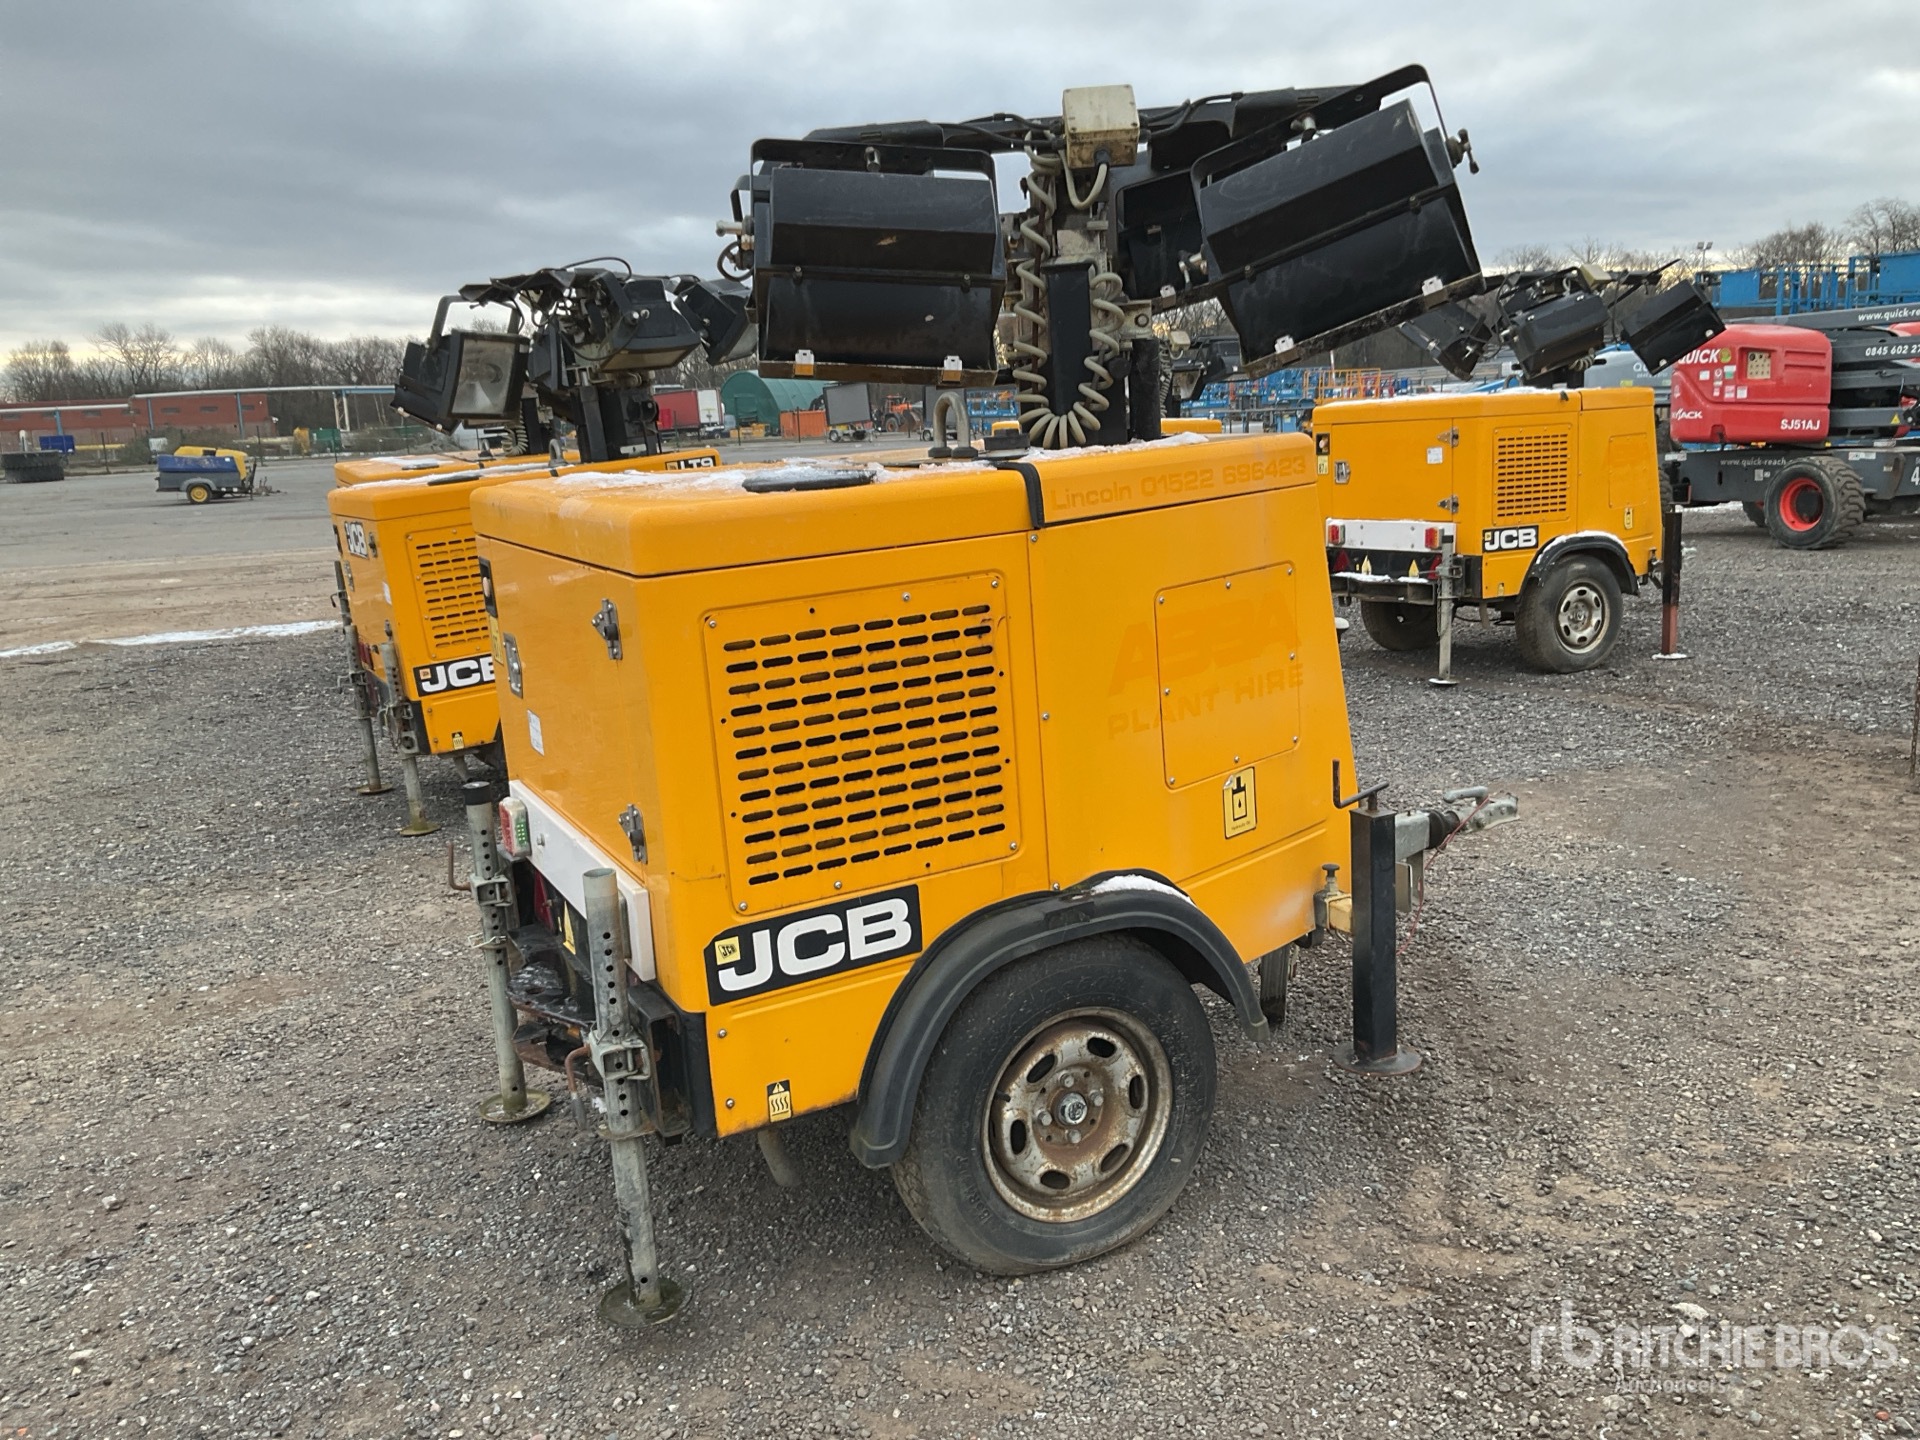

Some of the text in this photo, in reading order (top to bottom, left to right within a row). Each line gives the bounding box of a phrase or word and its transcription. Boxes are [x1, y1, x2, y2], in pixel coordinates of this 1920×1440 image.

[1865, 346, 1888, 356] 0845
[1890, 345, 1909, 355] 602
[1780, 419, 1820, 431] SJ51AJ
[1051, 481, 1132, 511] Lincoln
[1140, 468, 1214, 498] 01522
[1484, 528, 1537, 551] JCB
[1108, 588, 1302, 698] ABBA
[1107, 663, 1304, 739] PLANT HIRE
[718, 898, 912, 992] JCB
